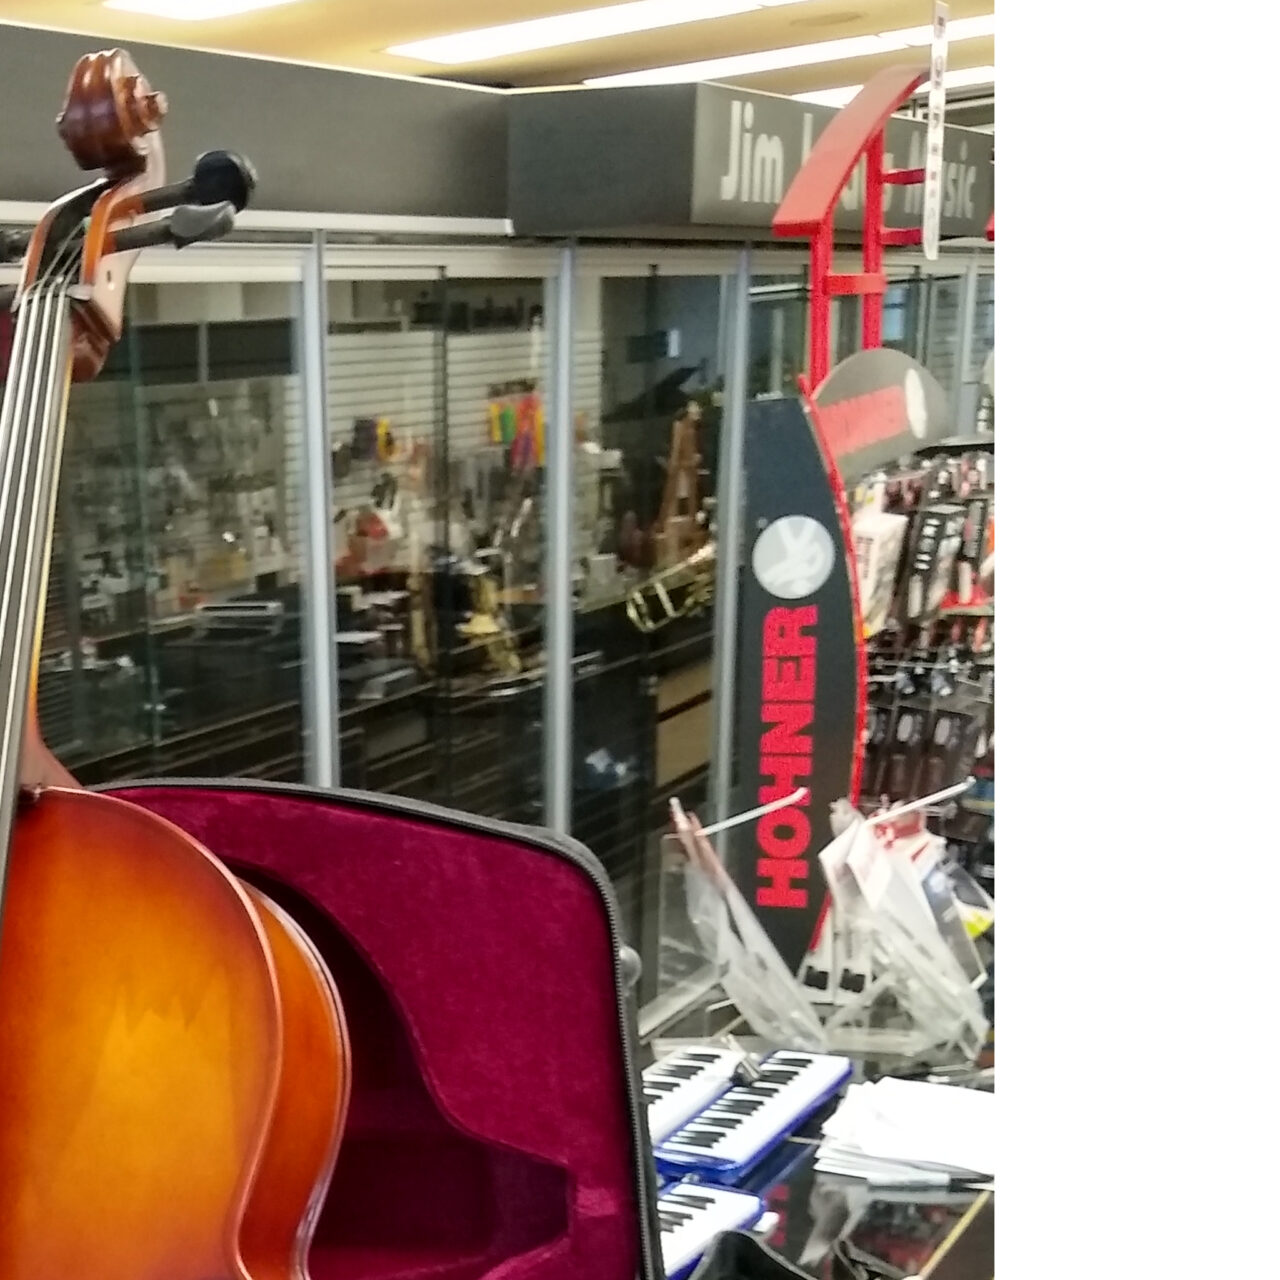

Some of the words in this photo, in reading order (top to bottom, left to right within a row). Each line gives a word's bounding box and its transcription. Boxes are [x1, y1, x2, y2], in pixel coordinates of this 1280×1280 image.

[721, 100, 785, 204] Jim
[904, 130, 976, 219] Msic
[756, 604, 818, 908] HOHNER
